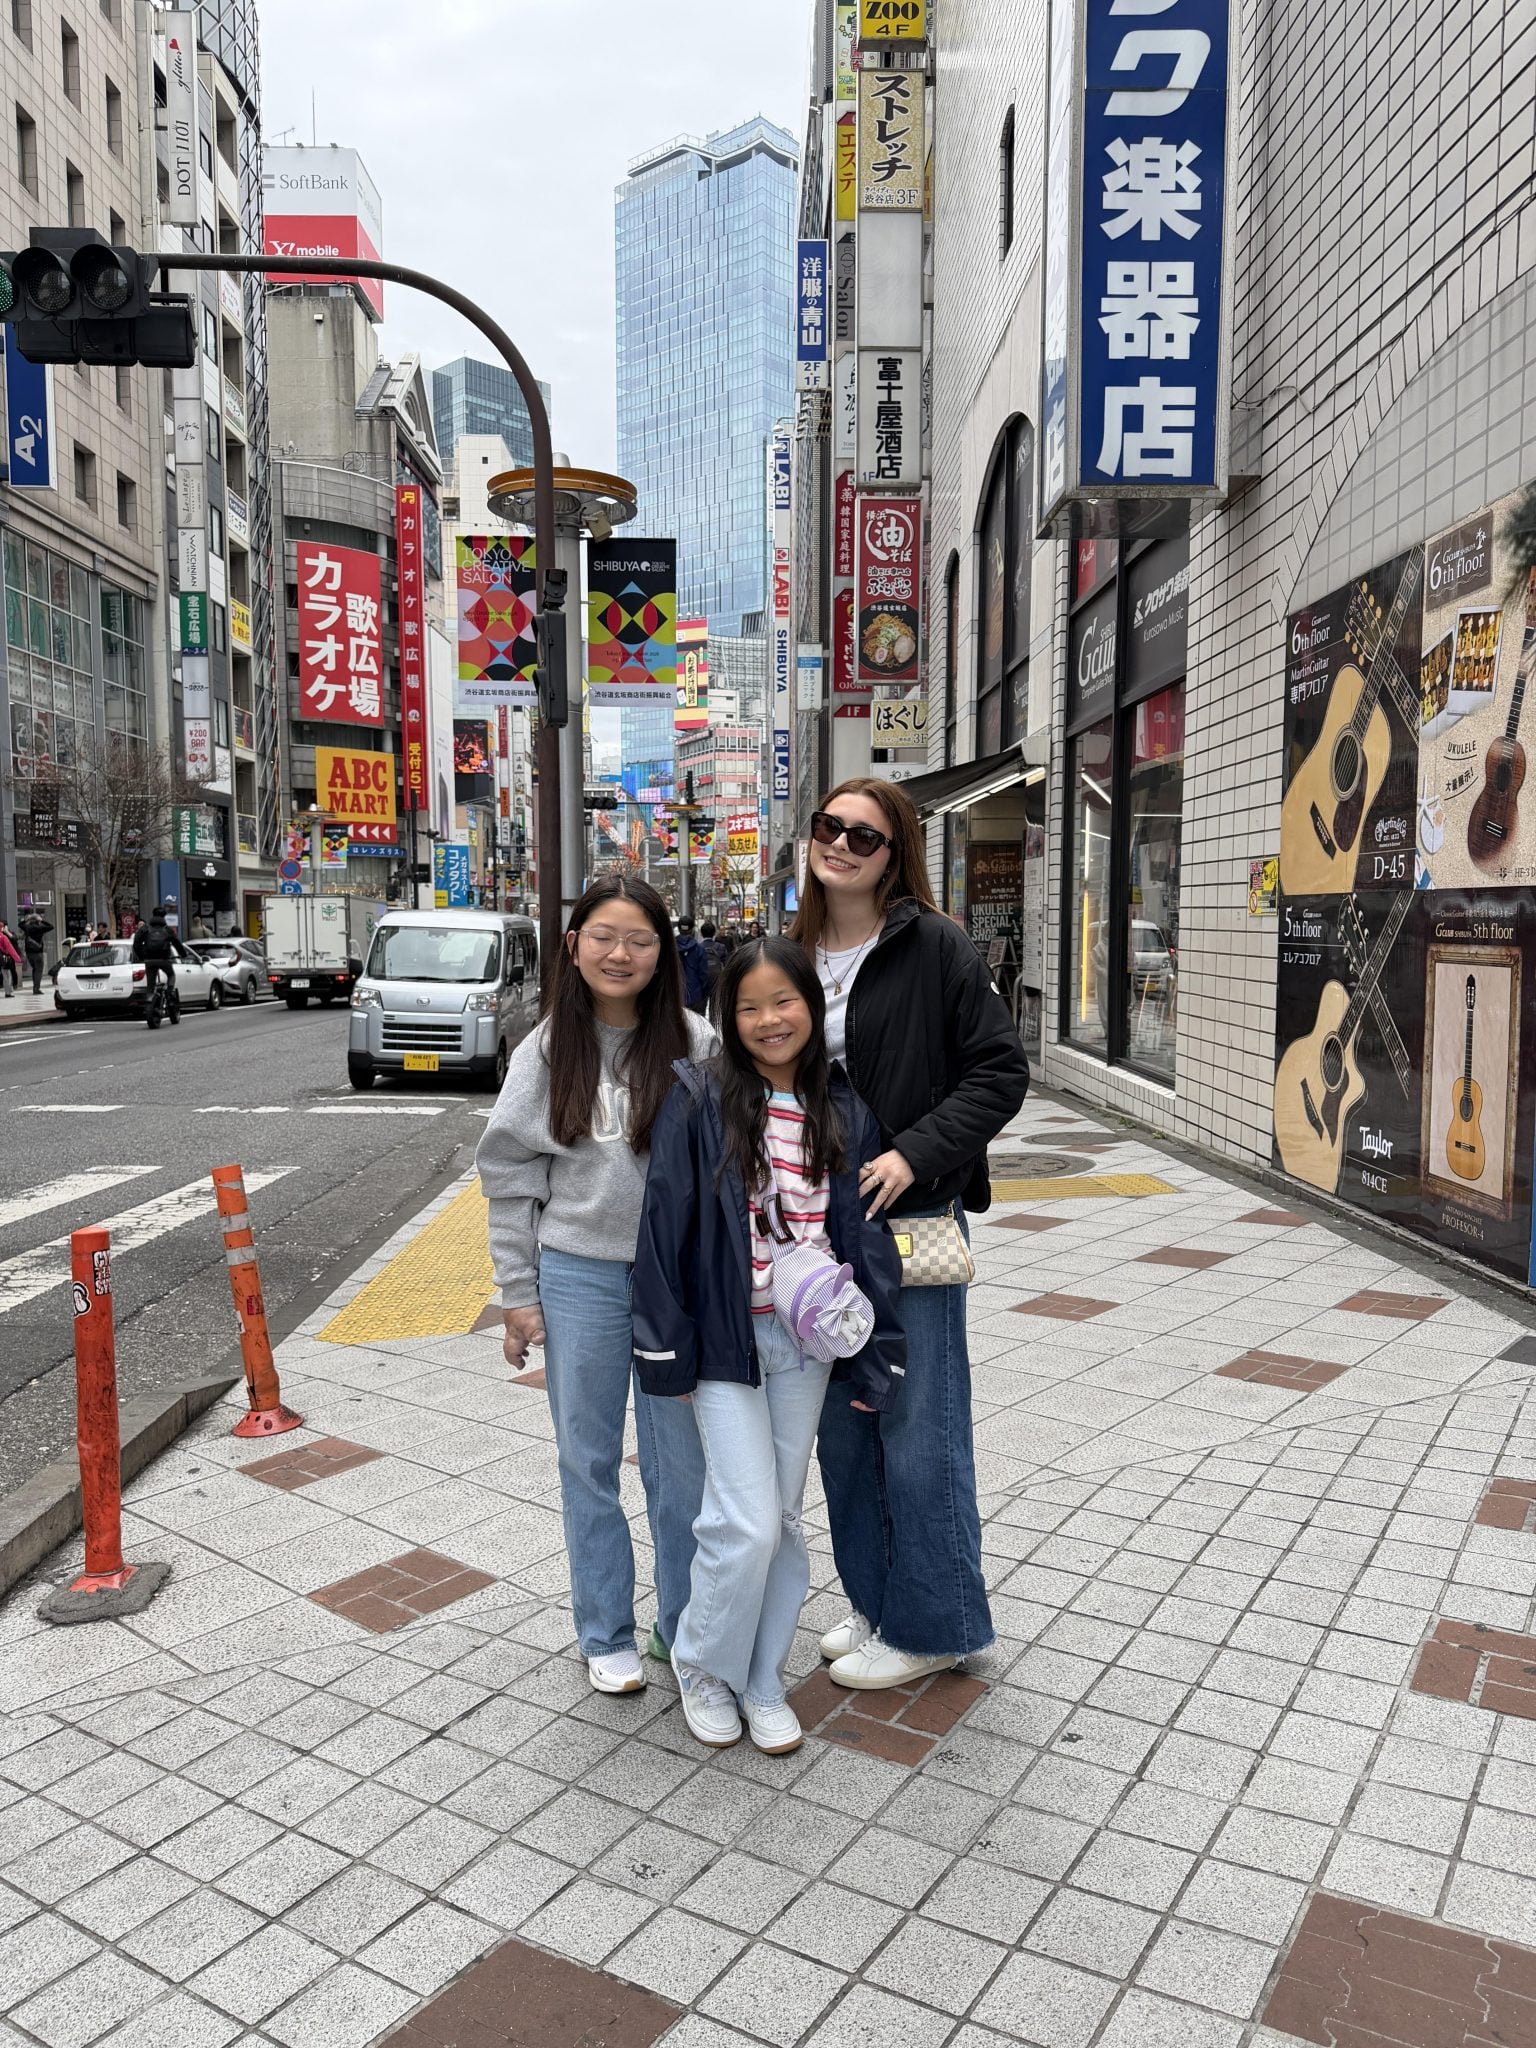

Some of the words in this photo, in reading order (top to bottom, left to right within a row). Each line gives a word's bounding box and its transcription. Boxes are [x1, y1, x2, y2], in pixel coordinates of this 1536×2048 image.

[866, 2, 919, 20] ZOO
[876, 24, 910, 35] 4F
[871, 74, 912, 183] ストレッチ
[839, 133, 856, 193] エステ
[280, 174, 348, 190] SoftBank
[864, 194, 894, 204] 渋谷店
[897, 189, 918, 205] 3F
[1096, 0, 1211, 477] ワ楽器店
[801, 257, 823, 346] 洋服の青山
[837, 276, 855, 338] Salon
[804, 363, 821, 372] 2F
[804, 376, 821, 386] 1F
[876, 357, 903, 479] 富士屋酒店
[15, 414, 42, 467] A2
[775, 459, 790, 506] LABI
[866, 511, 887, 521] 横浜
[906, 504, 917, 513] 1F
[875, 516, 905, 548] 油
[462, 547, 512, 561] TOKYO
[462, 559, 531, 573] CREATIVE
[593, 560, 640, 572] SHIBUYA
[890, 549, 912, 562] そば
[1457, 552, 1485, 578] floor
[463, 572, 512, 585] SALON
[775, 564, 790, 617] LABI
[403, 516, 420, 689] カラオケ歌広場
[187, 595, 201, 644] 宝石広場
[304, 551, 346, 712] カラオケ
[1144, 618, 1168, 643] Kurosawa
[1168, 605, 1184, 627] Music
[1311, 626, 1330, 648] floor
[345, 592, 381, 718] 歌広場
[776, 628, 787, 693] SHIBUYA
[1290, 674, 1329, 705] 専門フロア
[876, 704, 928, 731] ほぐし
[189, 729, 207, 738] ¥200
[191, 738, 206, 748] BAR
[914, 733, 928, 744] 3F
[1447, 740, 1477, 754] UKULELE
[328, 756, 388, 793] ABC
[775, 753, 789, 798] LABI
[328, 791, 388, 815] MART
[449, 849, 460, 902] コンタクト
[460, 856, 468, 896] メガネスーパー
[1373, 854, 1406, 881] D-45
[971, 902, 1014, 917] UKULELE
[972, 915, 1012, 929] SPECIAL
[972, 928, 998, 941] SHOP
[1302, 920, 1322, 938] floor
[1473, 923, 1489, 939] 5th
[1490, 922, 1514, 940] floor
[1360, 1126, 1393, 1160] Taylor
[1361, 1169, 1388, 1194] 814CE
